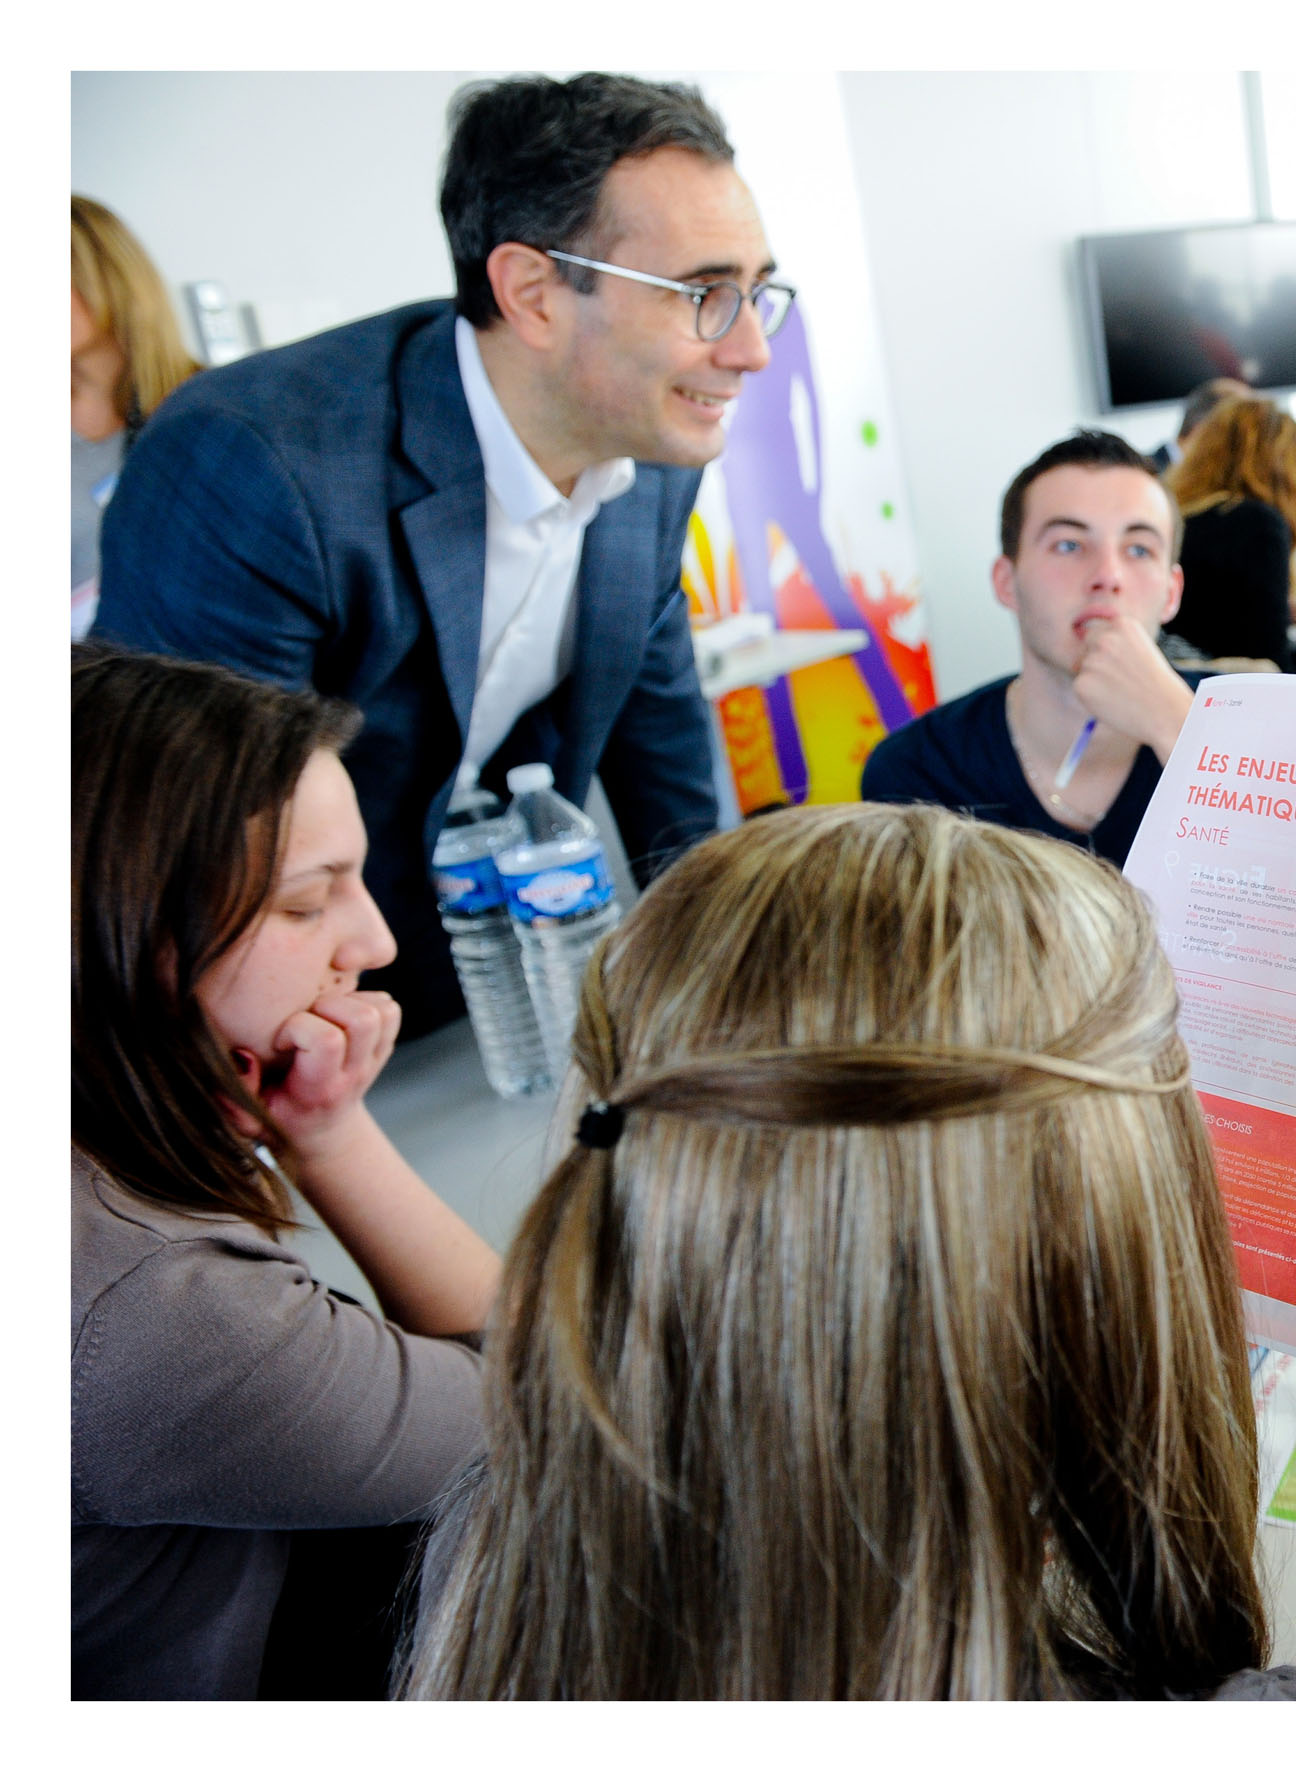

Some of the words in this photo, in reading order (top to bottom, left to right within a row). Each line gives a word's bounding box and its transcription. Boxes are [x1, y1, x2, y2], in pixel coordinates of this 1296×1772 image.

[1197, 746, 1229, 773] LES
[1176, 816, 1230, 846] SANTÉ
[1216, 1115, 1253, 1135] CHOISIS
